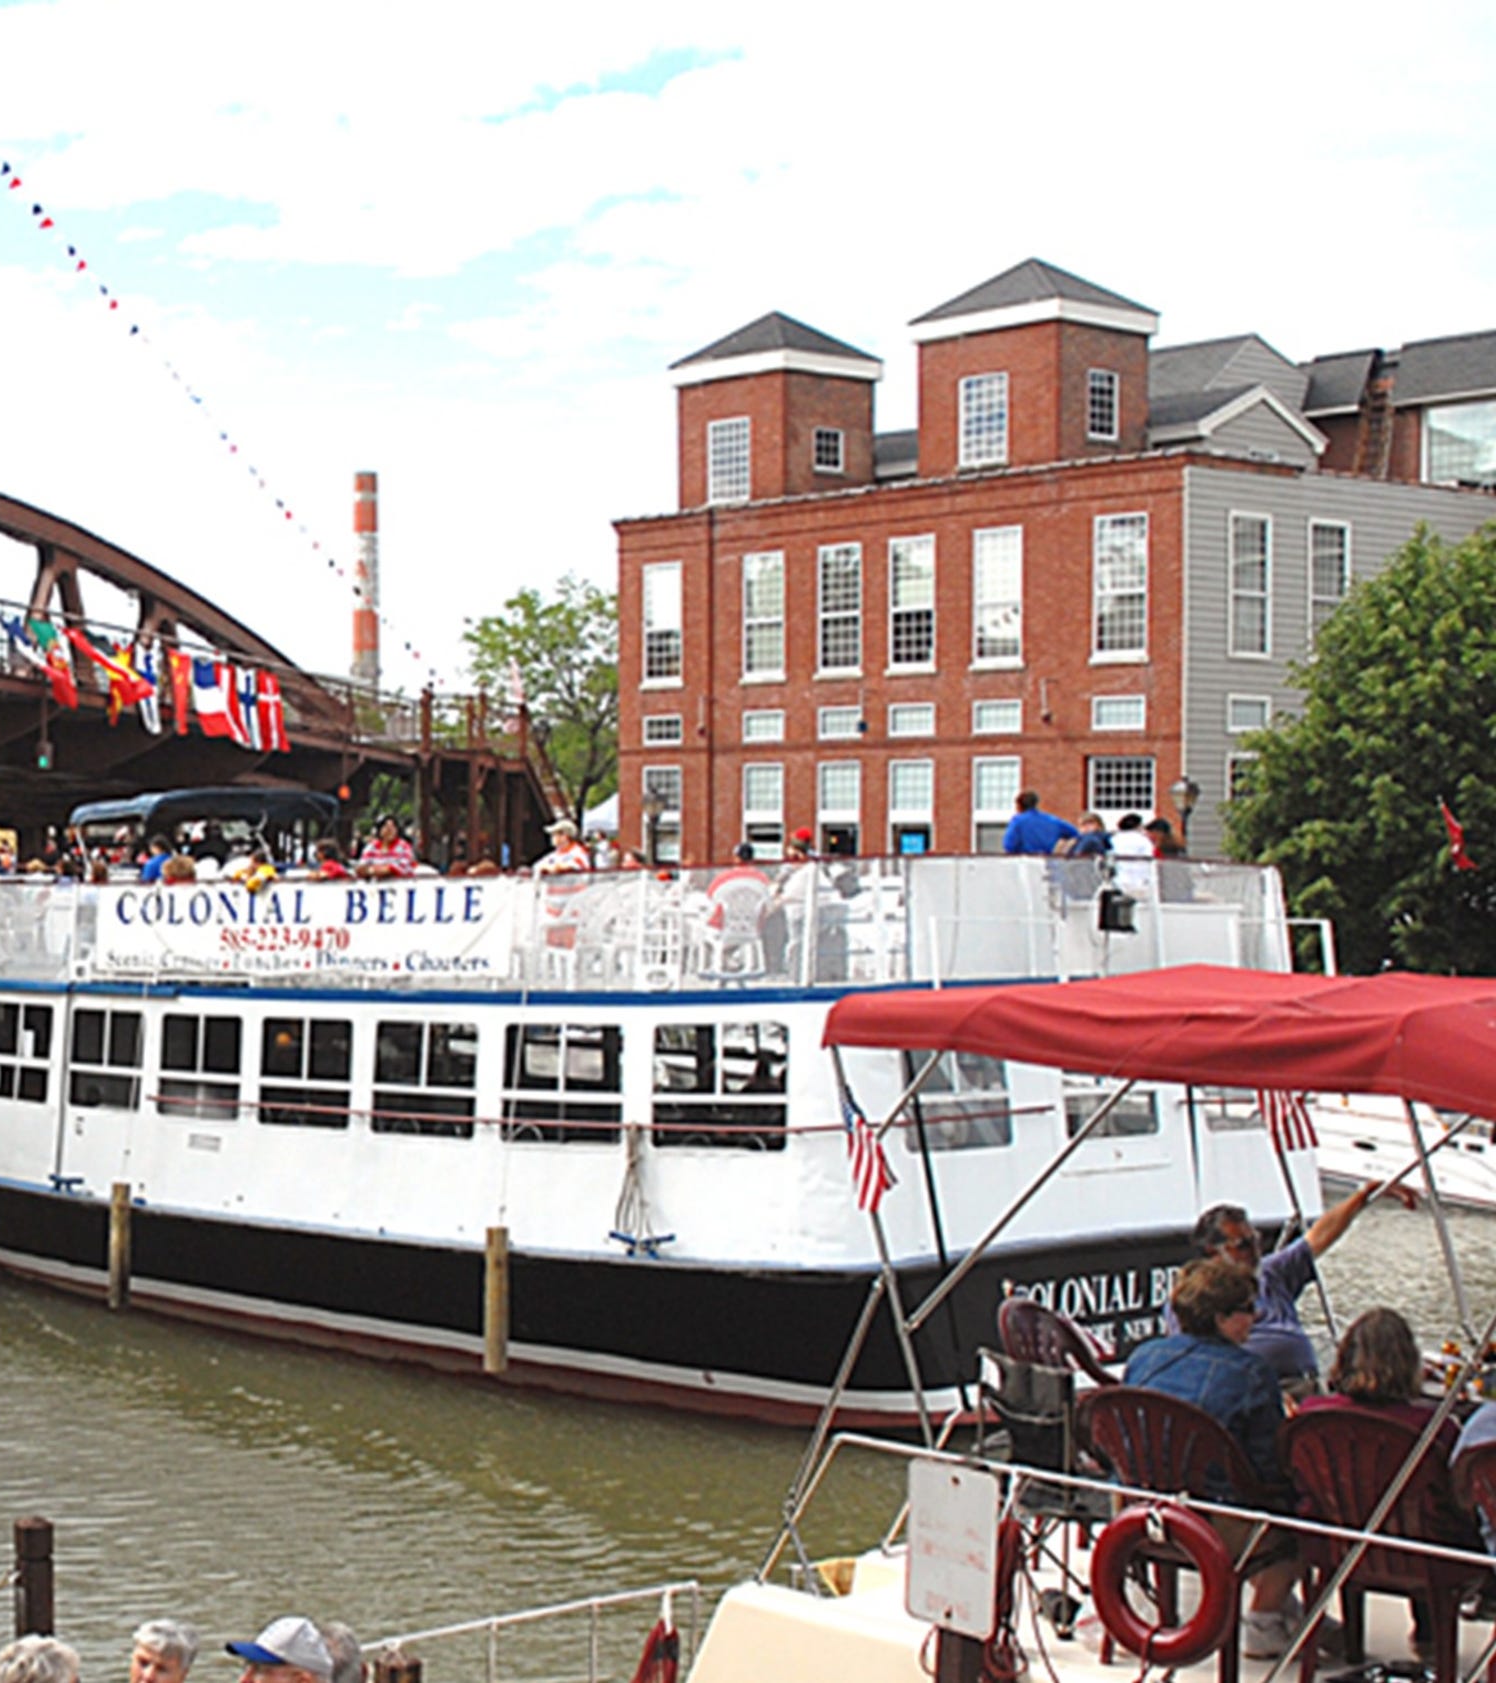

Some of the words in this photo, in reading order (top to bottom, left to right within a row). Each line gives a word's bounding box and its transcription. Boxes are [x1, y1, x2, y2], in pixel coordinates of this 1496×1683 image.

[115, 889, 311, 925] COLONIAL
[345, 885, 484, 924] BELLE
[219, 926, 350, 951] 585-223-9470
